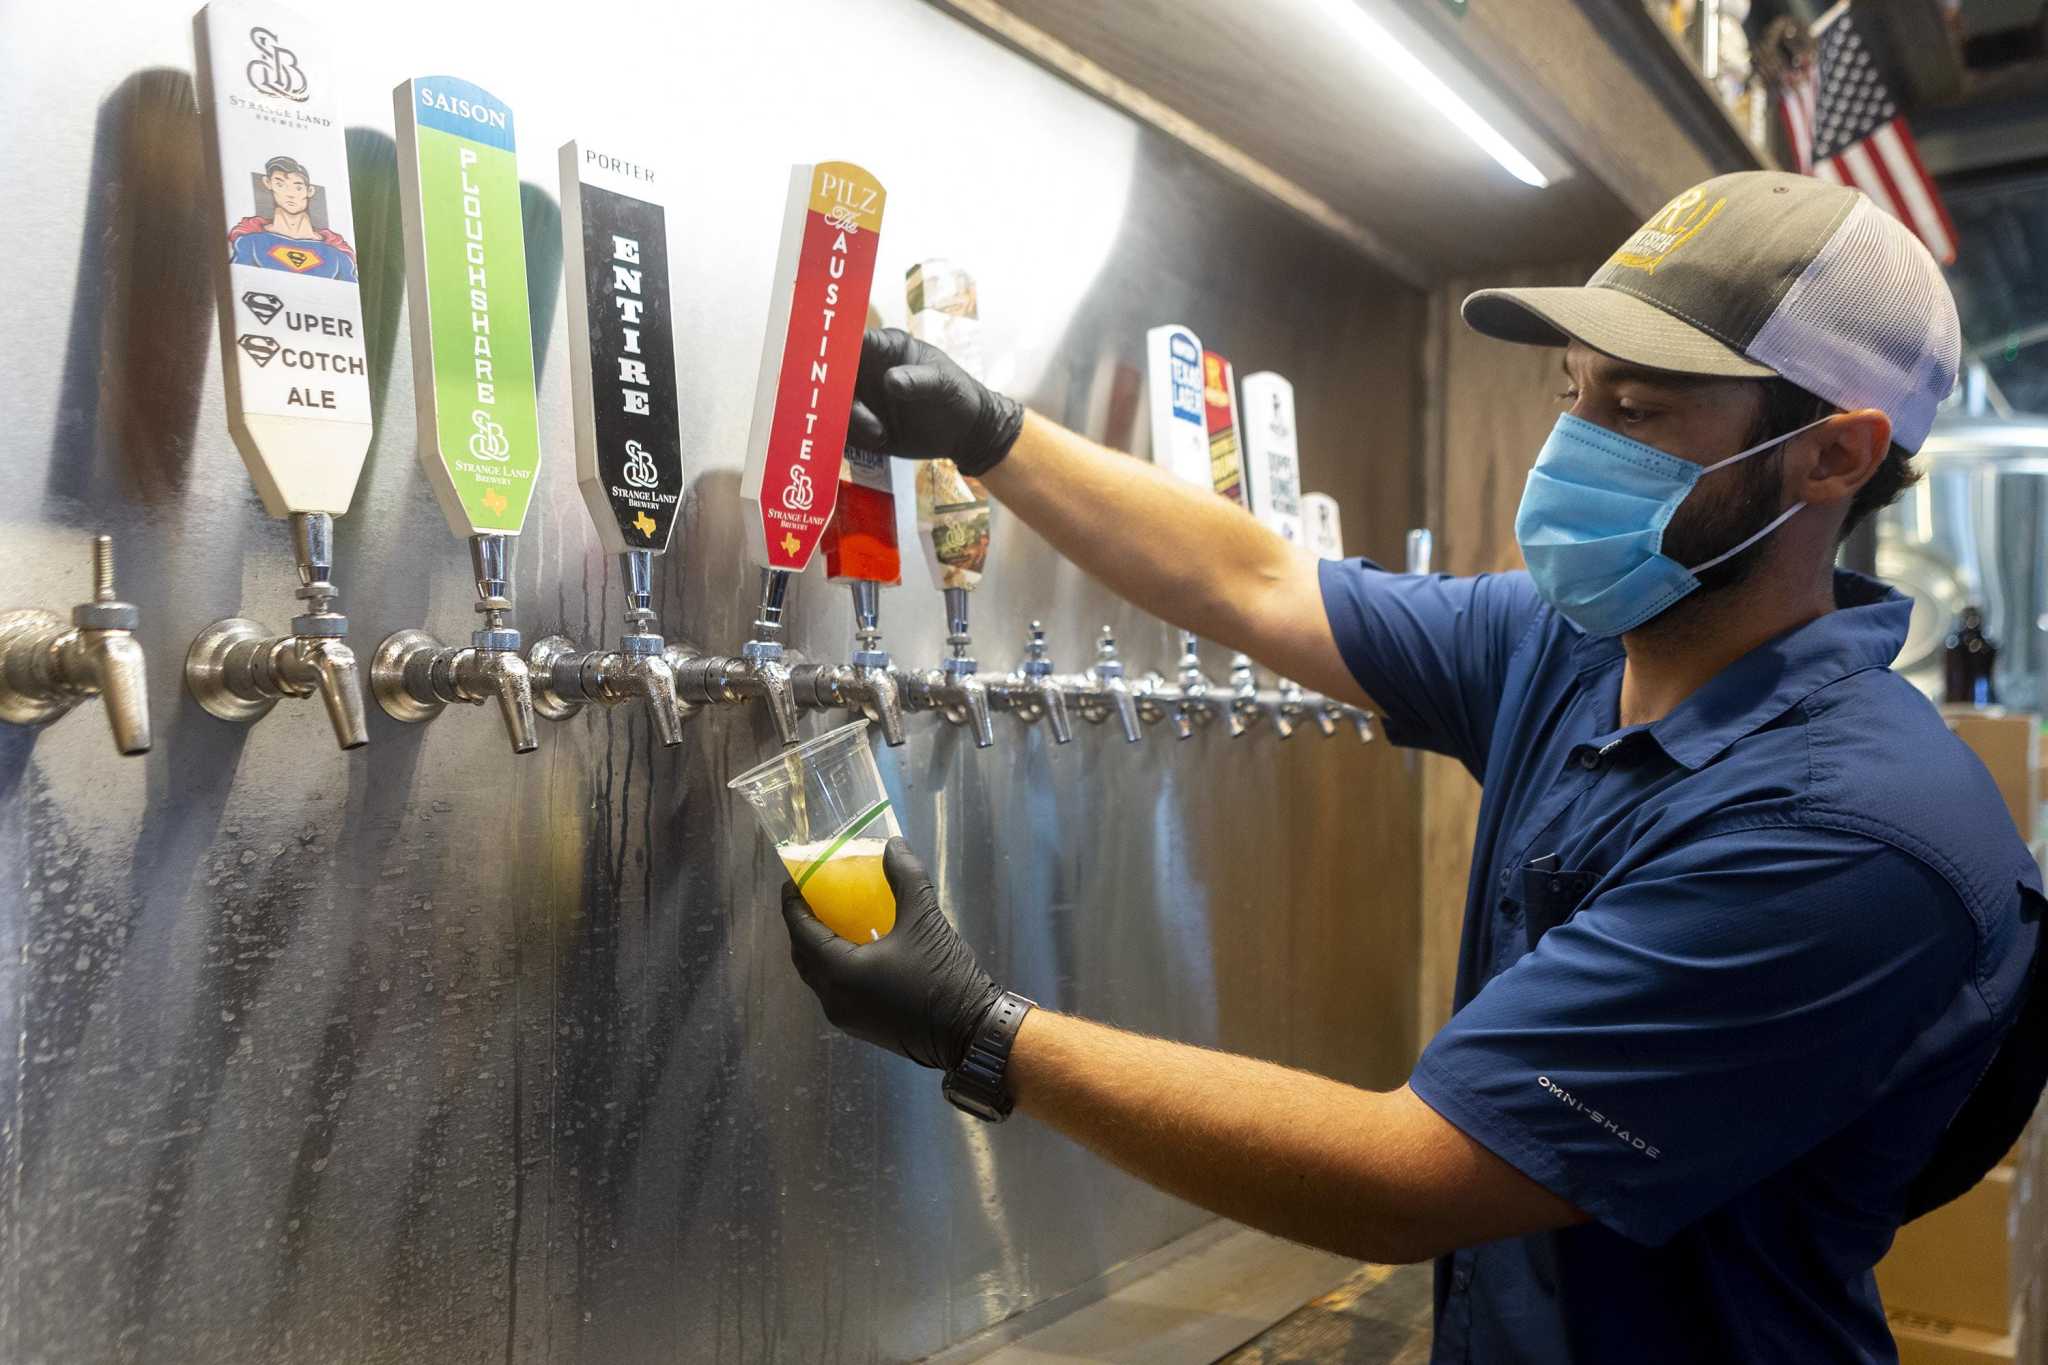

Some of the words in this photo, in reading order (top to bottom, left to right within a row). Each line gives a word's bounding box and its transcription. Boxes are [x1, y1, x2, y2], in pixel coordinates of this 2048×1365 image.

[296, 110, 332, 128] LAND
[421, 88, 506, 129] SAISON
[586, 150, 655, 183] PORTER
[820, 171, 878, 215] PILZ
[824, 205, 861, 234] The
[460, 147, 495, 404] PLOUGHSHARE
[612, 235, 650, 416] ENTIRE
[800, 231, 848, 461] AUSTINITE
[287, 387, 336, 409] ALE
[455, 460, 500, 476] STRANGE
[503, 466, 530, 480] LAND
[475, 473, 512, 486] BREWERY
[612, 486, 650, 500] STRANGE
[652, 491, 677, 504] LAND
[628, 498, 660, 510] BREWERY
[768, 508, 801, 522] STRANGE
[803, 513, 825, 526] LAND
[780, 520, 808, 531] BREWERY
[1538, 1076, 1661, 1159] OMNI-SHADE
